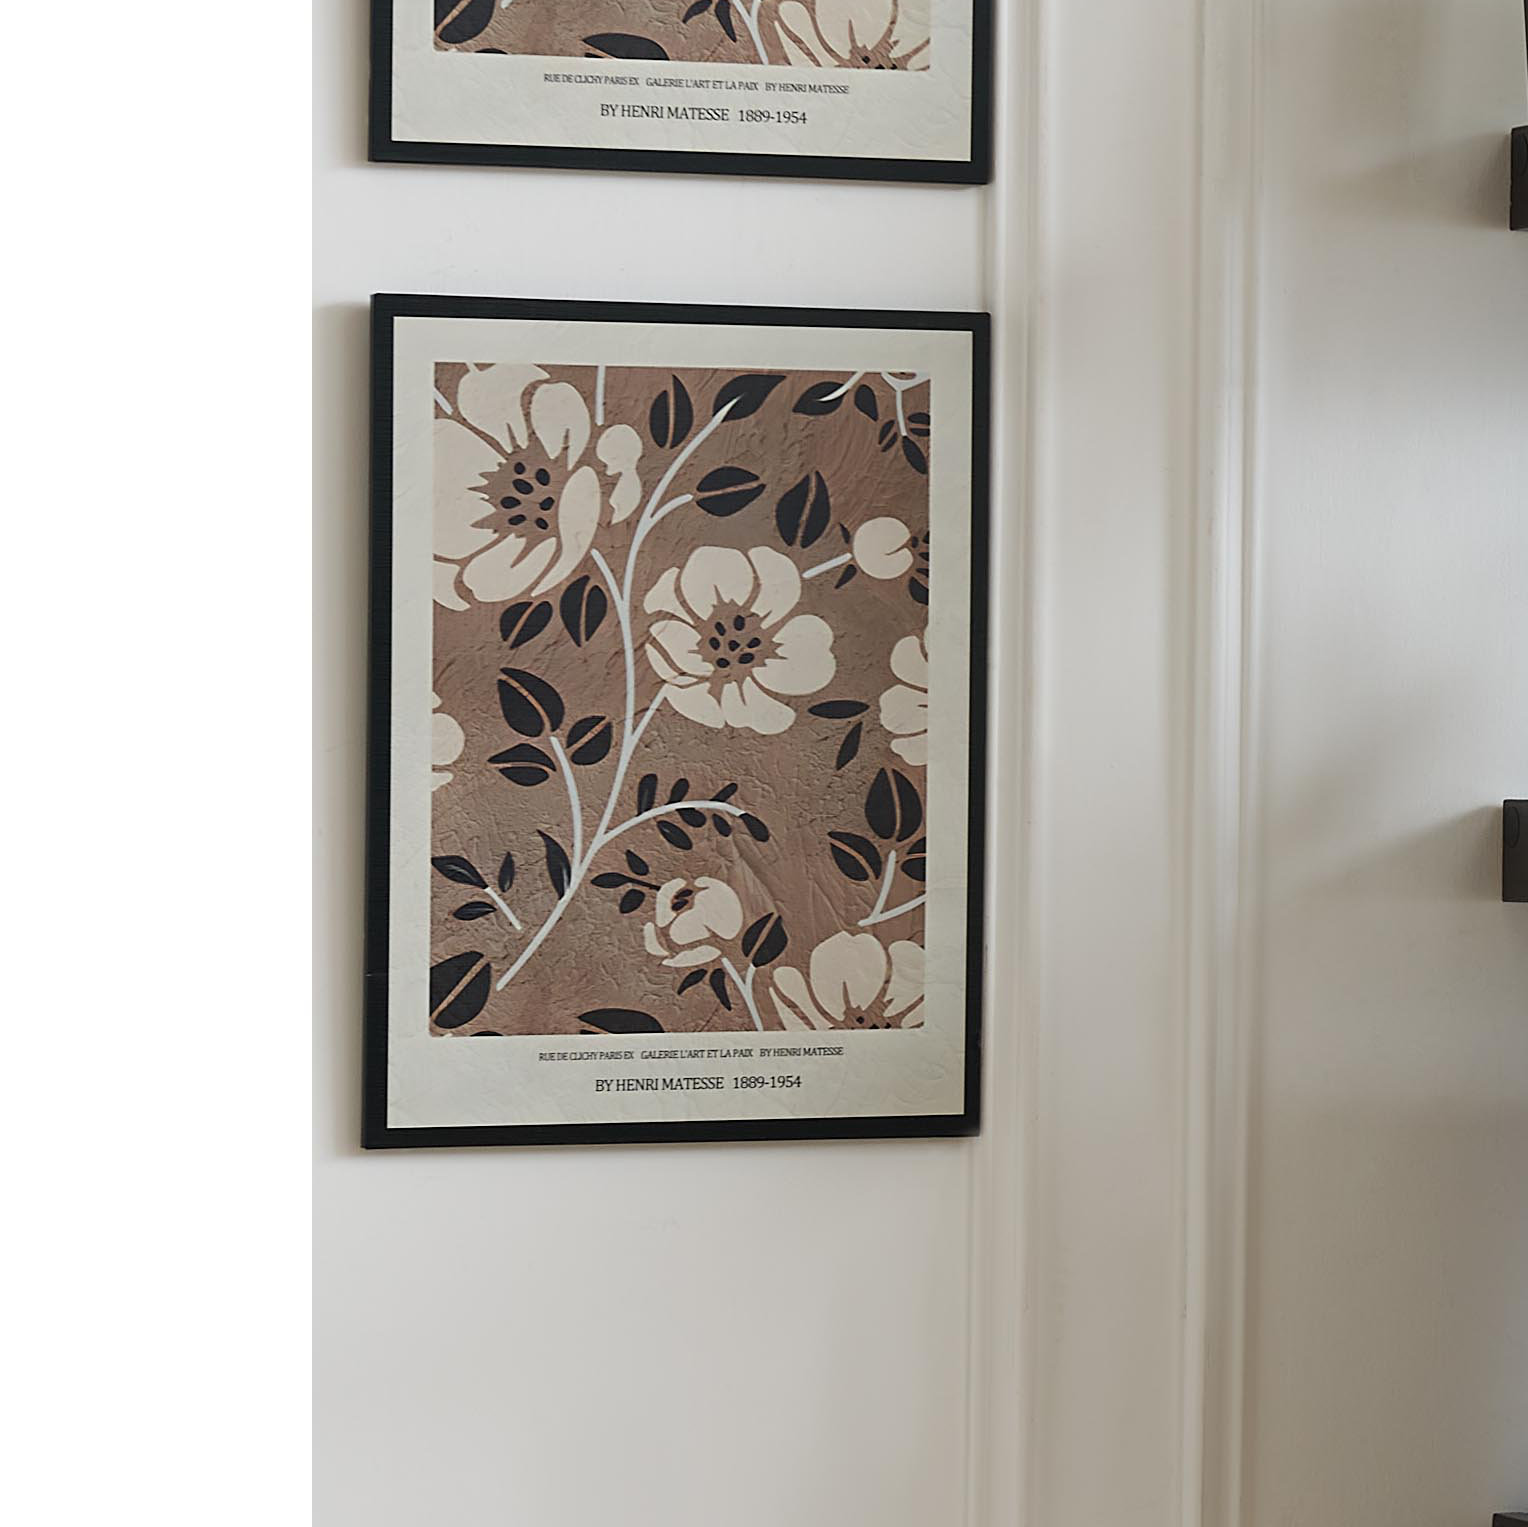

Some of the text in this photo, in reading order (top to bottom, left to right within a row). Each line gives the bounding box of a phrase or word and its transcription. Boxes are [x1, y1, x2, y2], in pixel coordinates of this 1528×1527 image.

[562, 74, 575, 83] DE
[604, 76, 629, 85] PARIS
[712, 80, 724, 90] ET
[725, 80, 737, 90] LA
[765, 82, 778, 92] BY
[778, 83, 808, 93] HENRI
[599, 102, 808, 125] BY HENRI MATESSE 1889-1954
[556, 1051, 569, 1061] DE
[599, 1050, 623, 1060] PARIS
[706, 1049, 718, 1059] ET
[720, 1049, 731, 1058] LA
[760, 1048, 773, 1058] BY
[773, 1047, 801, 1057] HENRI
[595, 1075, 802, 1092] BY HENRI MATESSE 1889-1954
